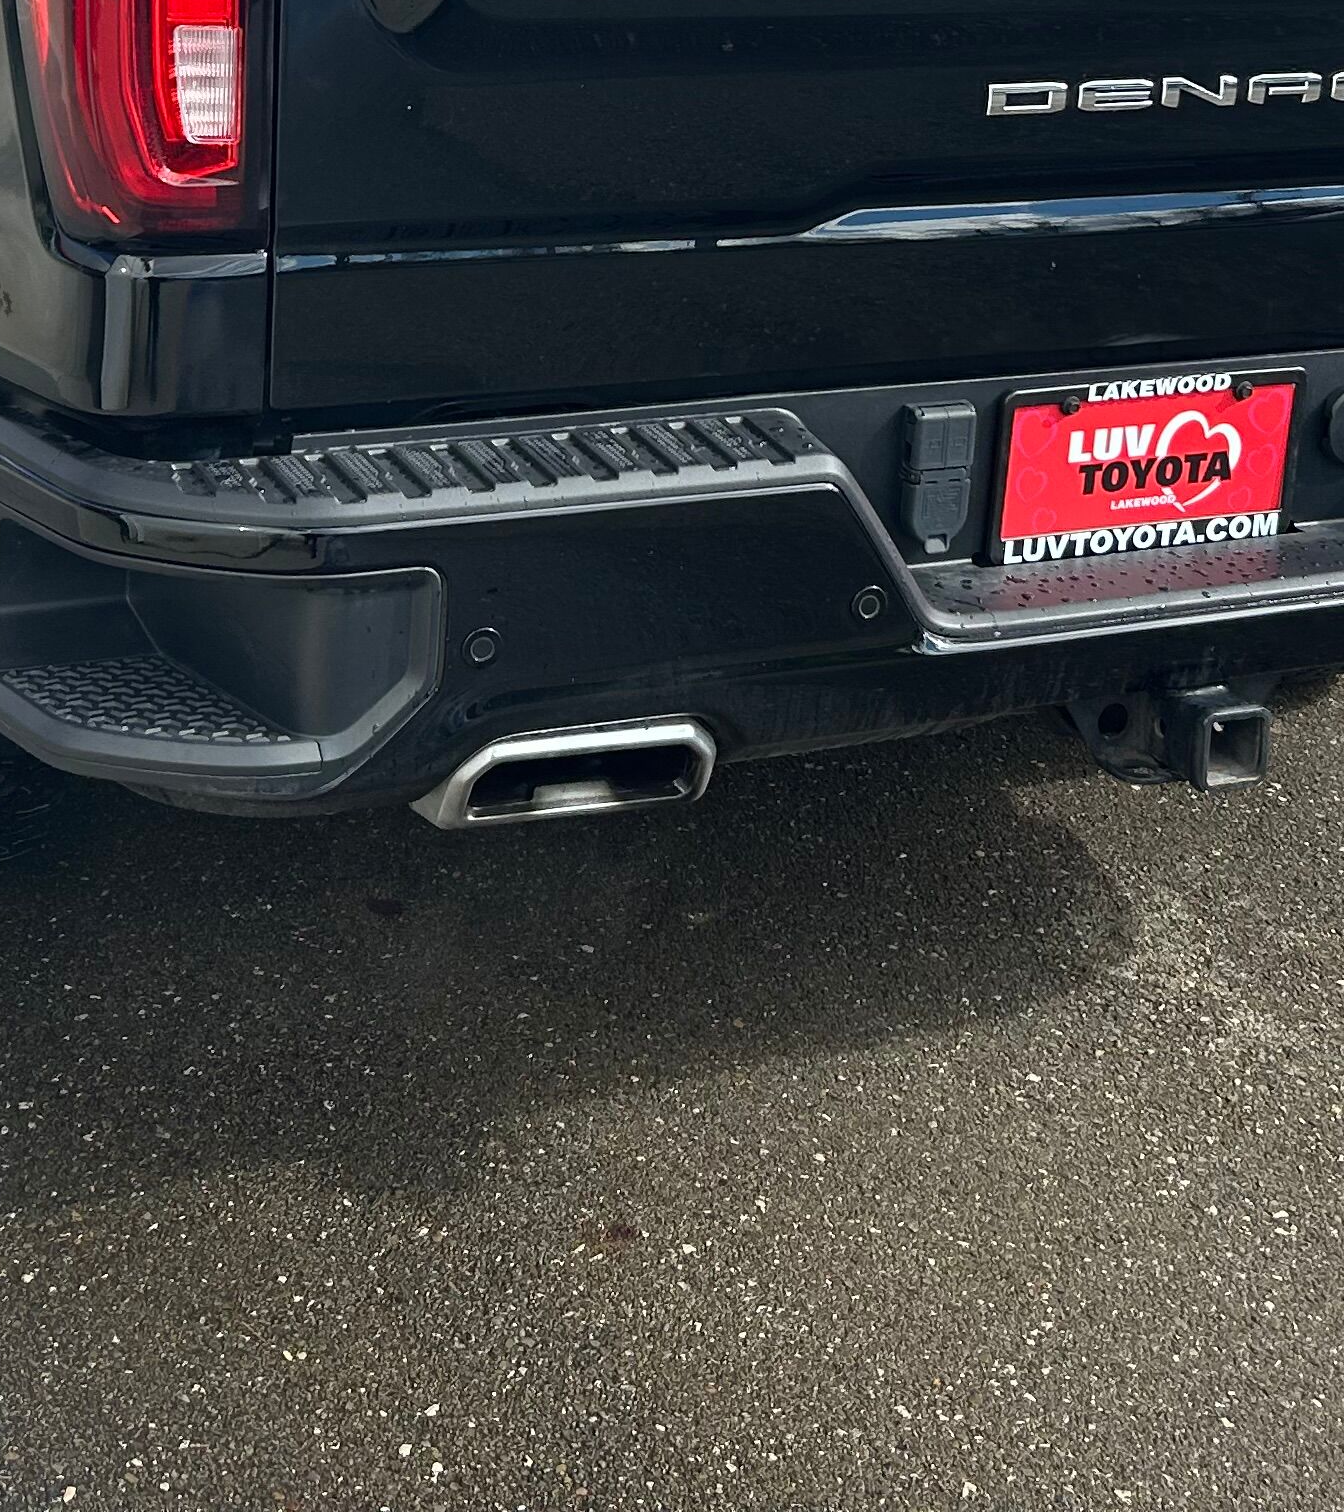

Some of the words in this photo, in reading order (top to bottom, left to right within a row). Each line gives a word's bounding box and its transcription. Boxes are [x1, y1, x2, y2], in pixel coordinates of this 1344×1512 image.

[1087, 373, 1232, 403] LAKEWOOD
[1067, 423, 1157, 464] LUV
[1078, 450, 1232, 496] TOYOTA
[1109, 494, 1177, 511] LAKEWOOD
[1002, 512, 1280, 565] LUVTOYOTA.COM
